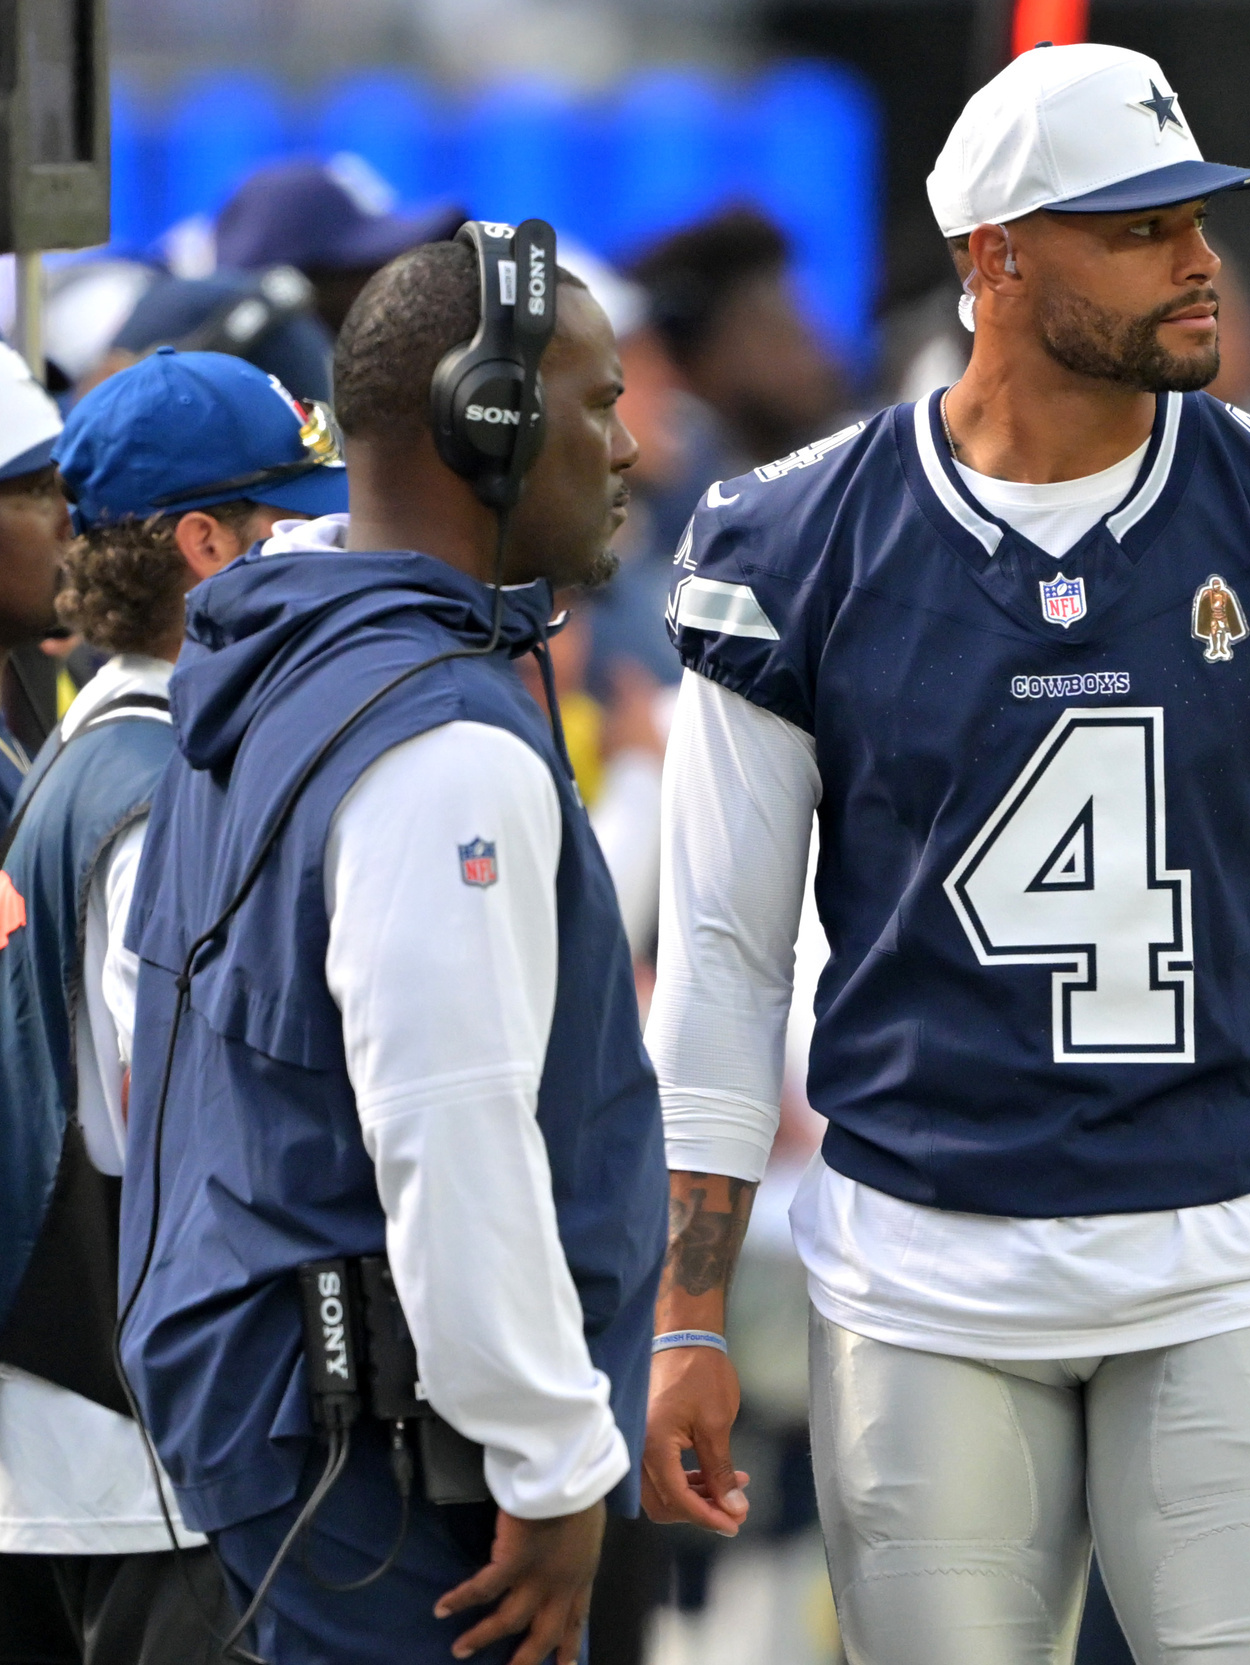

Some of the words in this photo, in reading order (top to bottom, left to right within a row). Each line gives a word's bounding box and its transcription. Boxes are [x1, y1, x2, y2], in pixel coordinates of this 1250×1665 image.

[528, 243, 545, 316] SONY
[1048, 597, 1080, 617] NFL
[1011, 671, 1130, 698] COWBOYS
[465, 859, 497, 882] NFL
[942, 706, 1195, 1063] 4
[318, 1271, 349, 1381] SONY
